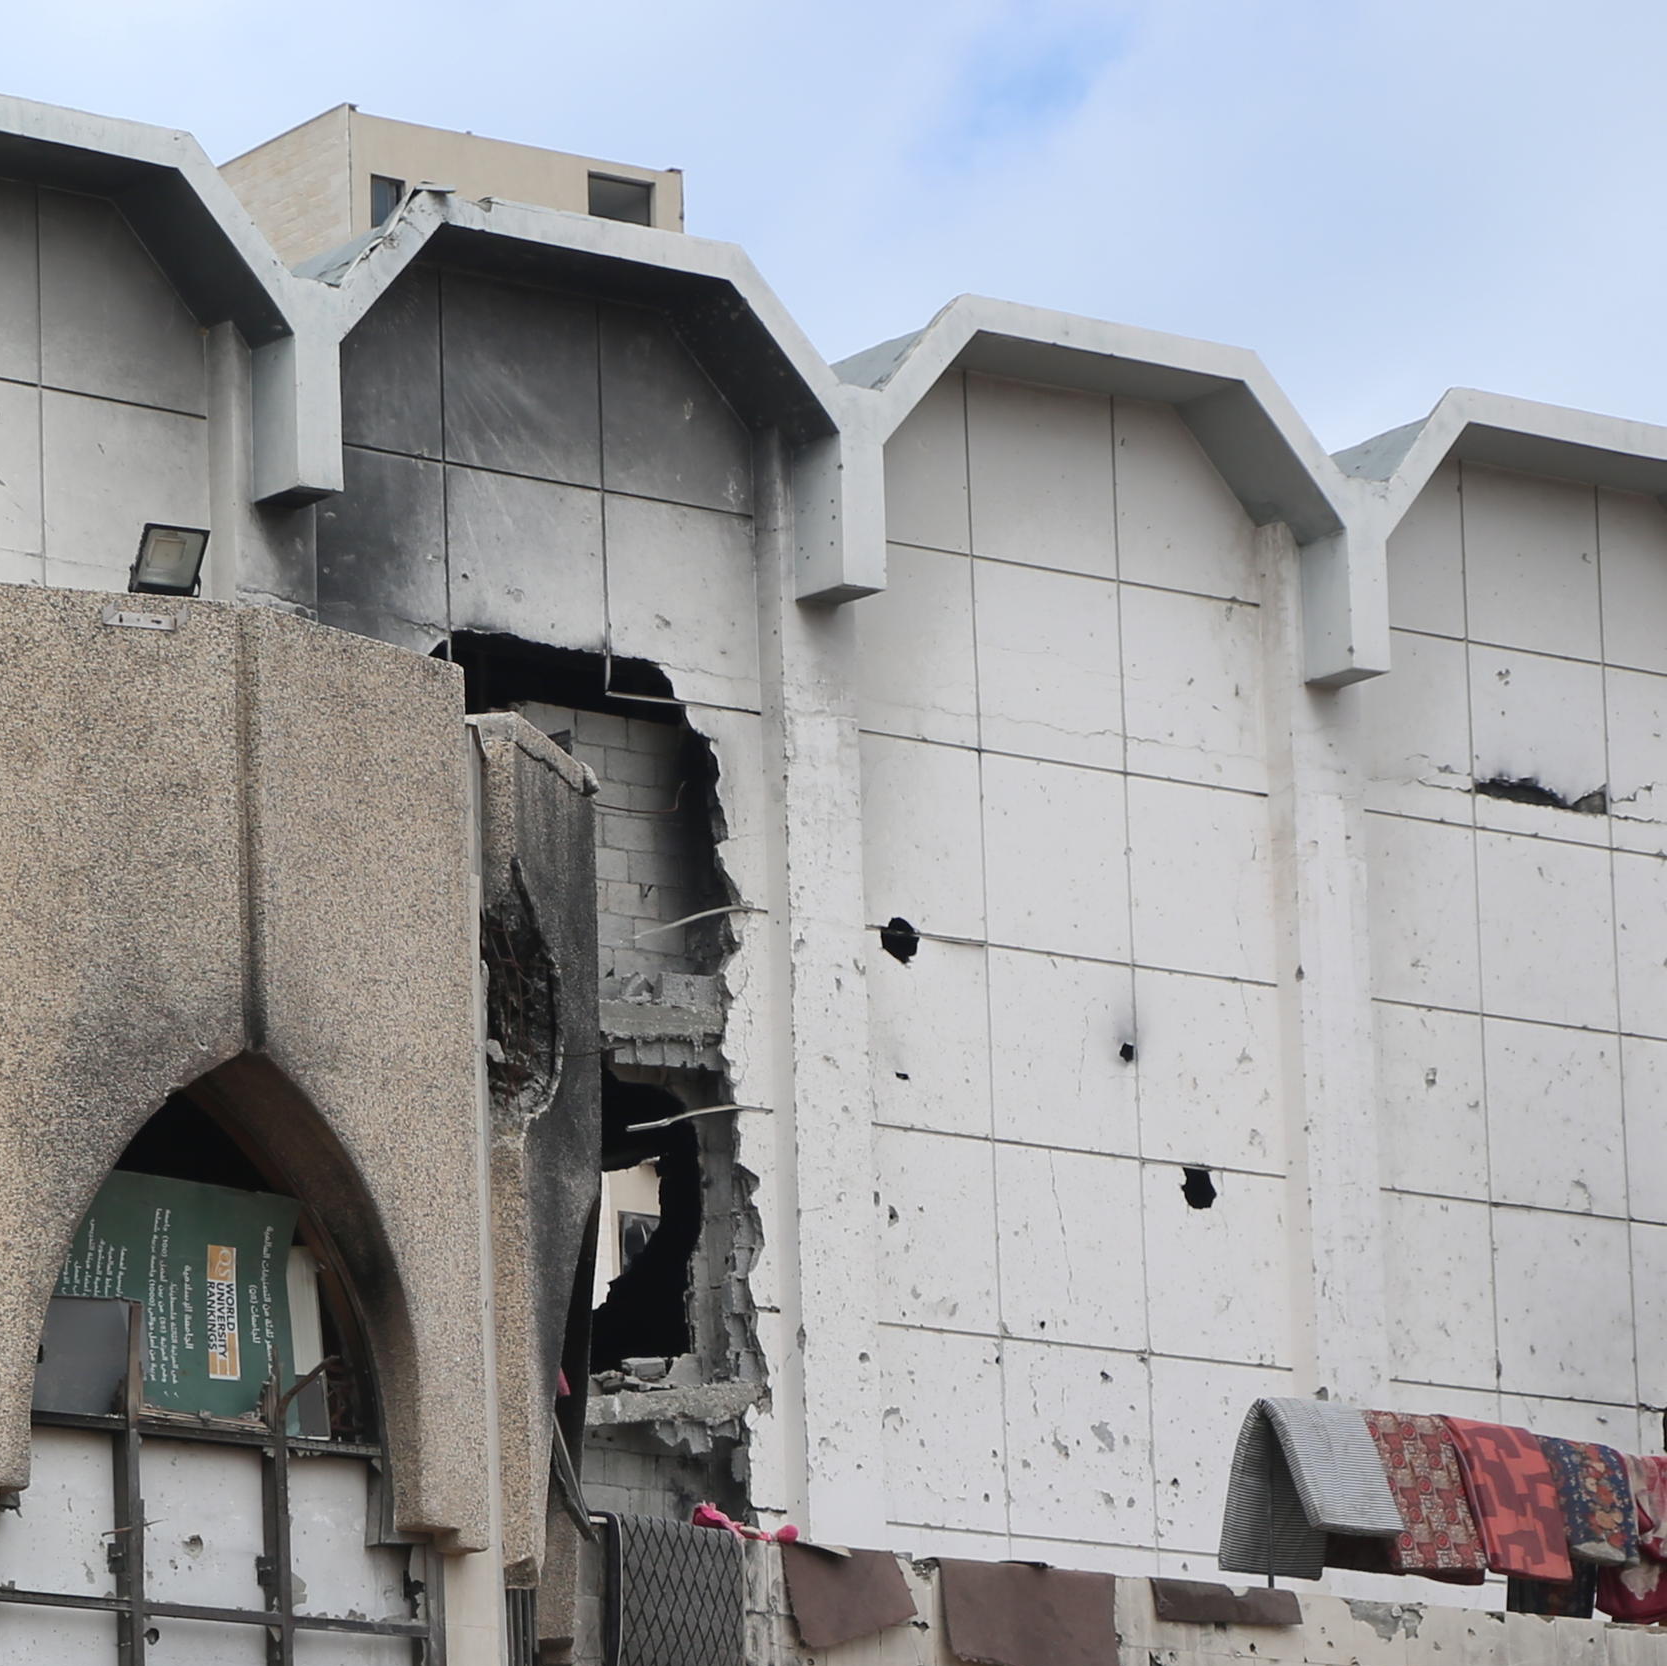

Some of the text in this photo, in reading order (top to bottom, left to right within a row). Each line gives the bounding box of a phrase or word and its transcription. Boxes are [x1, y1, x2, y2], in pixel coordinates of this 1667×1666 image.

[215, 1248, 233, 1279] QS
[207, 1281, 217, 1350] RANKINGS
[217, 1282, 227, 1358] UNIVERSITY
[226, 1283, 235, 1331] WORLD
[184, 1314, 194, 1349] الجامعة
